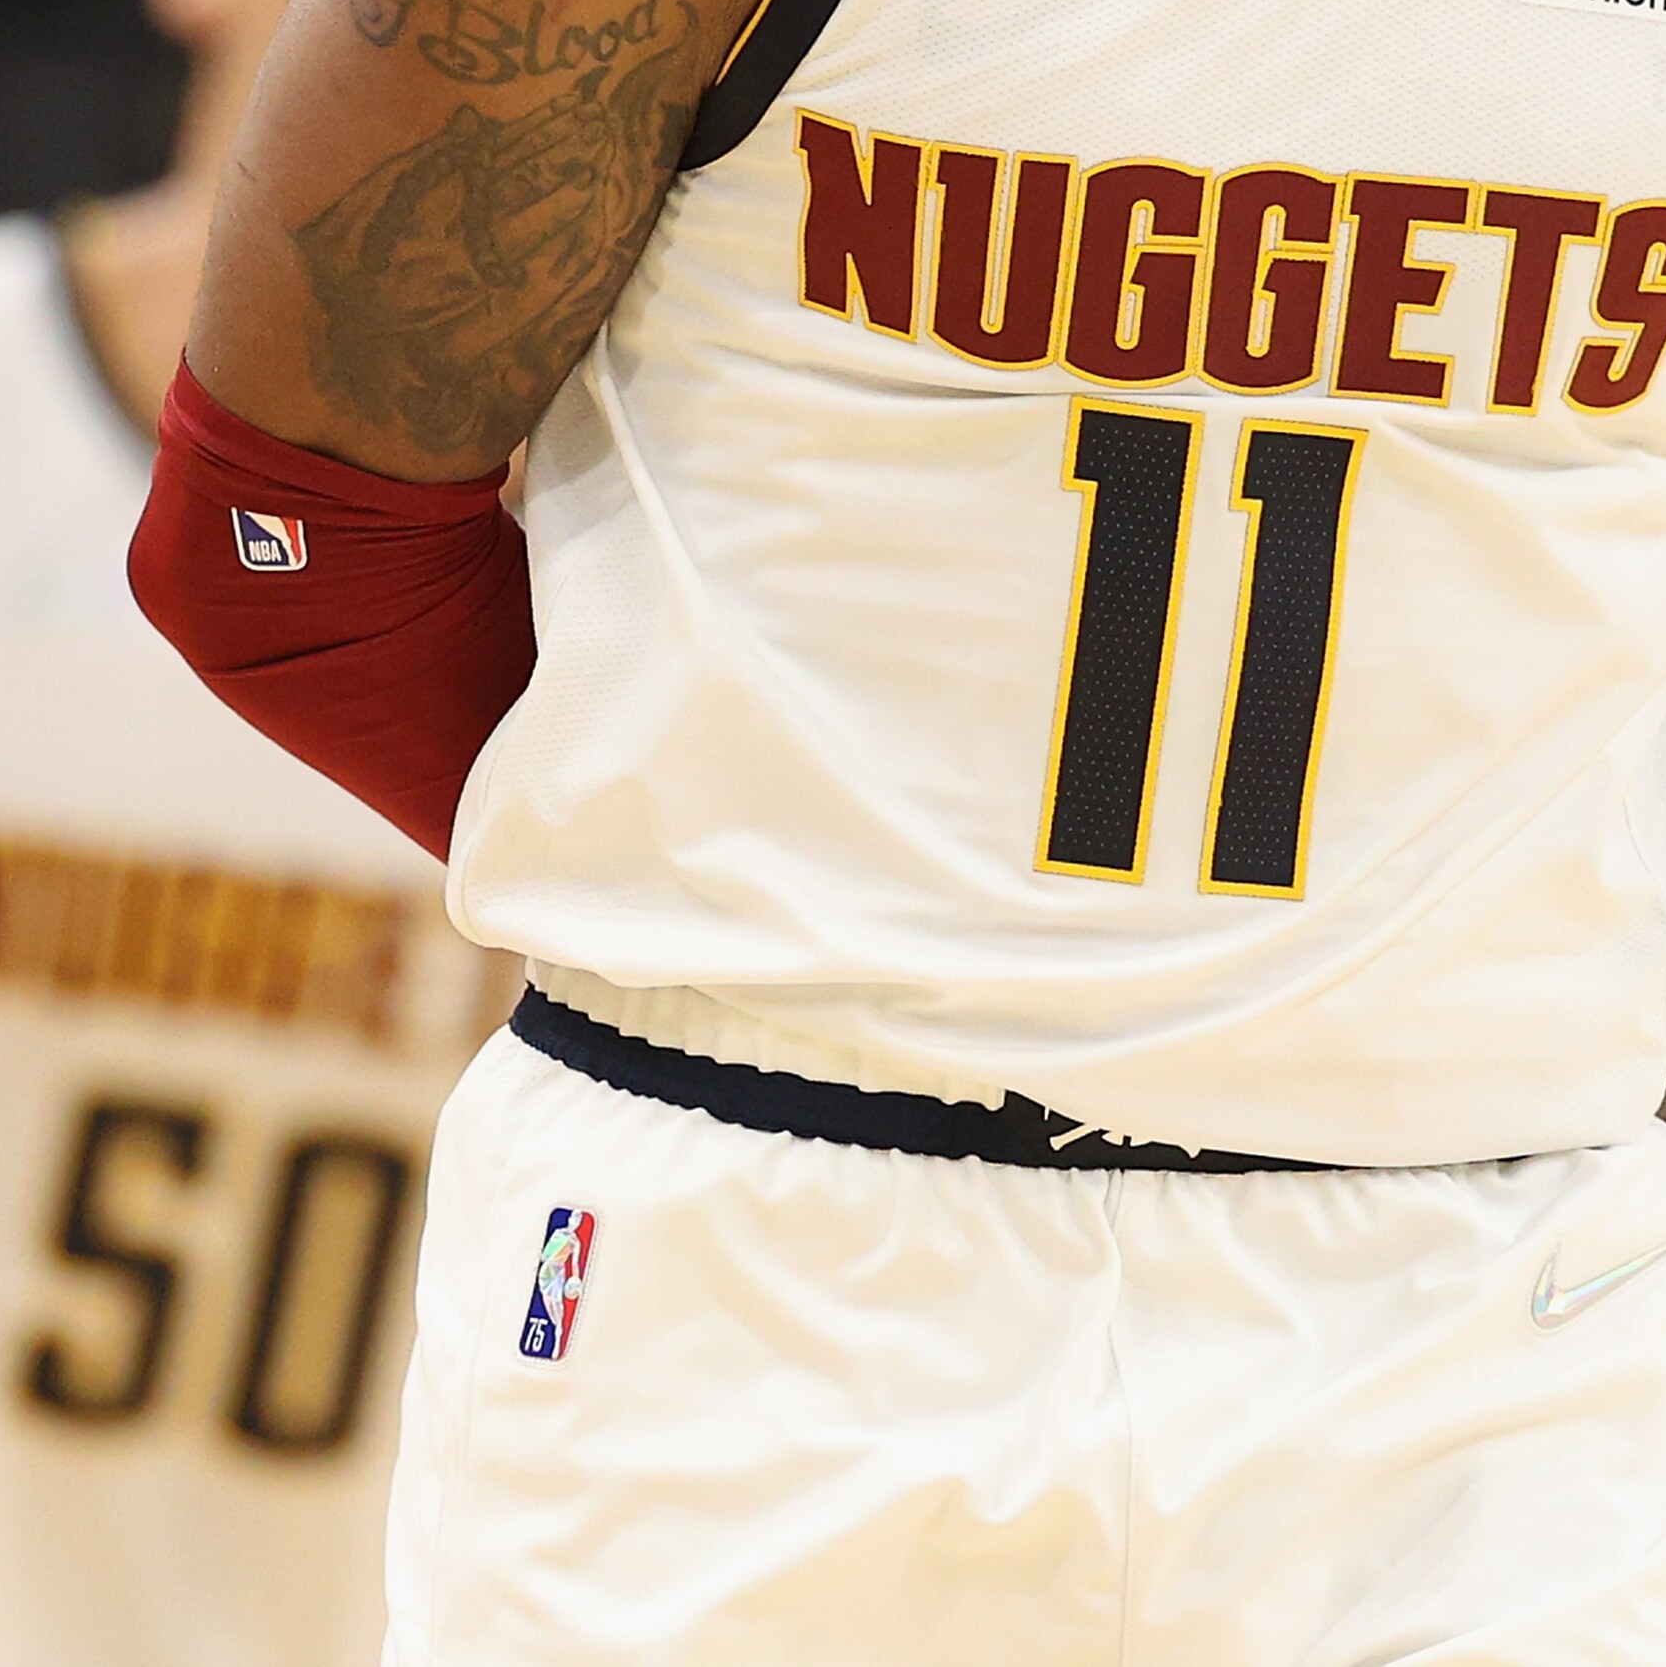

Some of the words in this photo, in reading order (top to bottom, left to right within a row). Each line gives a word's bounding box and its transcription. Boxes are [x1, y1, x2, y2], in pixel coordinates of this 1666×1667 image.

[248, 539, 282, 562] NBA
[1033, 395, 1369, 901] 11
[18, 1095, 417, 1455] 50
[524, 1317, 549, 1352] 75
